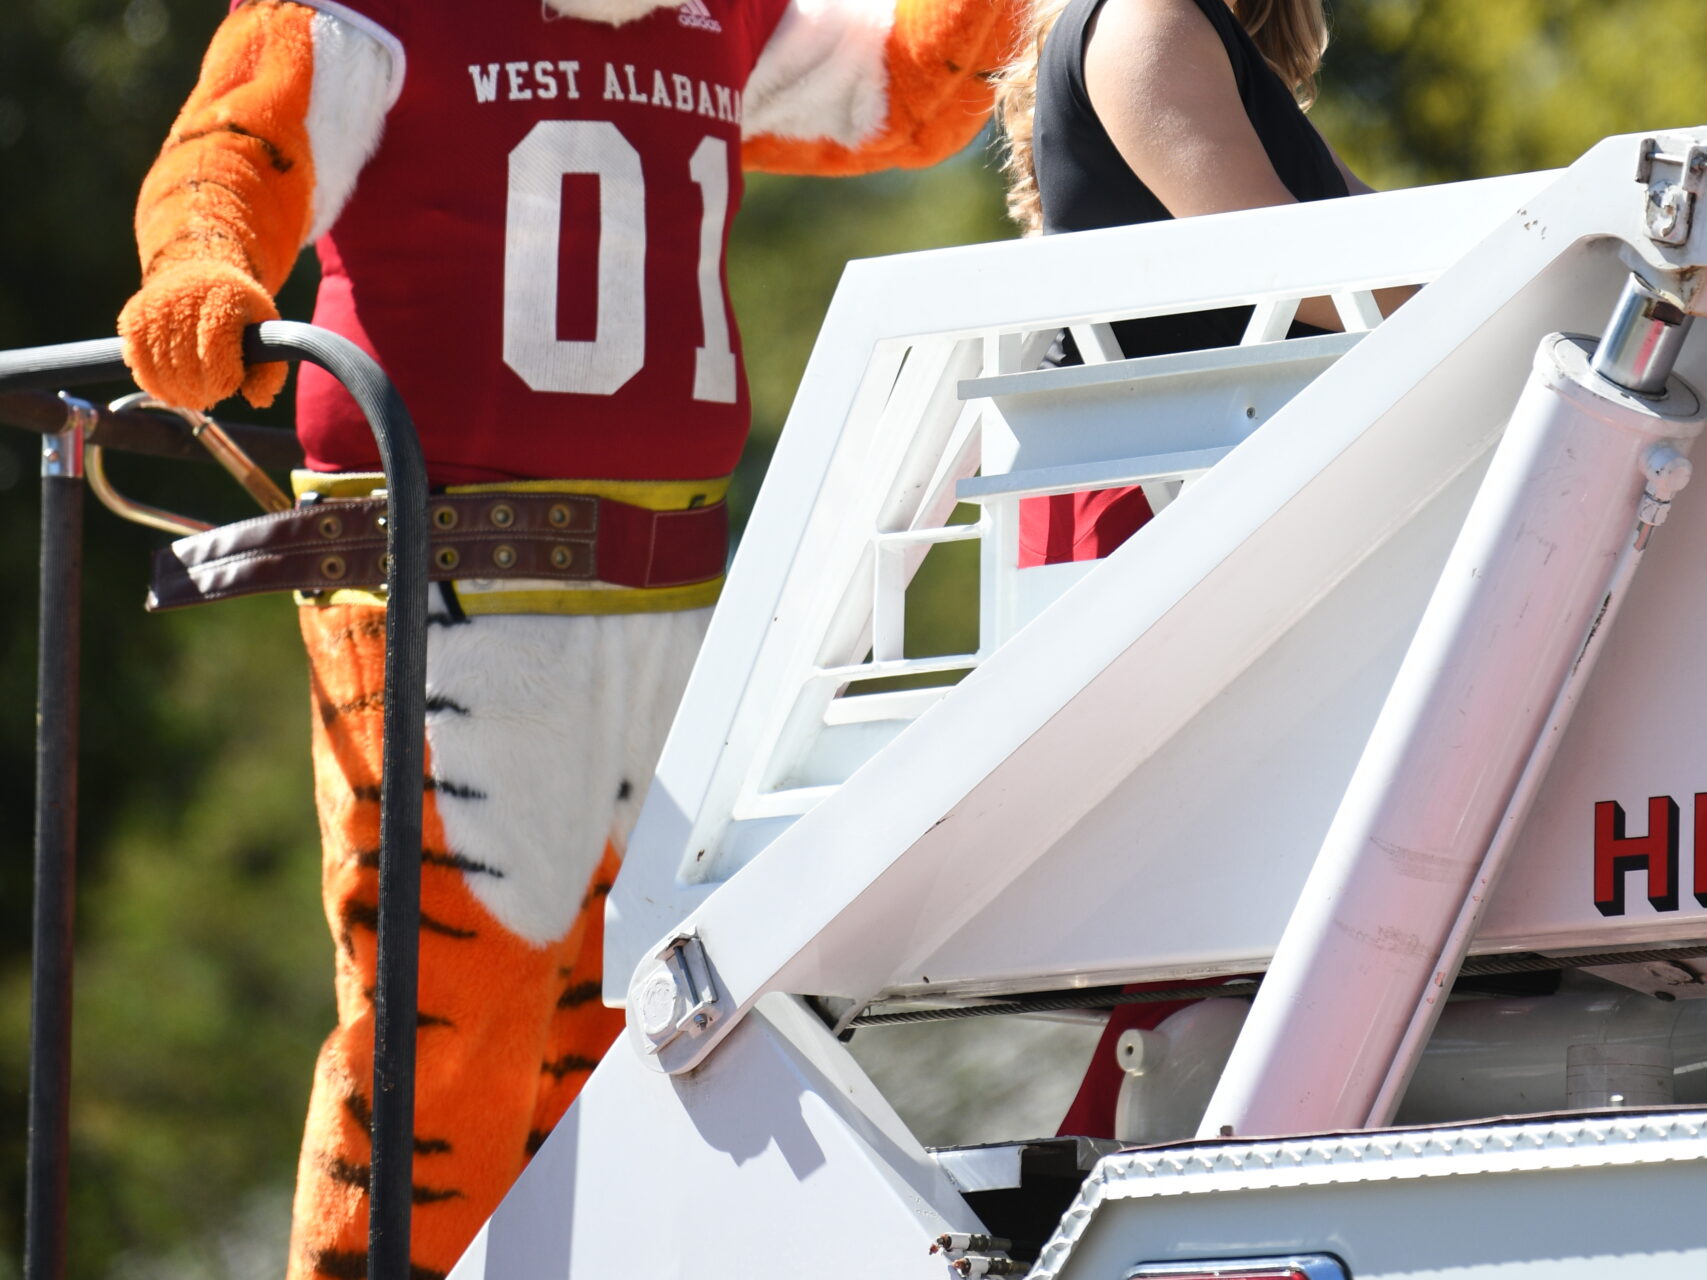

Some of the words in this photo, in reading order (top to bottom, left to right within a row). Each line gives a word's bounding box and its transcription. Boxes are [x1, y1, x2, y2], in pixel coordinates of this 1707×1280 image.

[678, 14, 722, 33] adidas
[468, 60, 580, 104] WEST
[502, 119, 738, 404] 01
[1593, 790, 1707, 917] H
